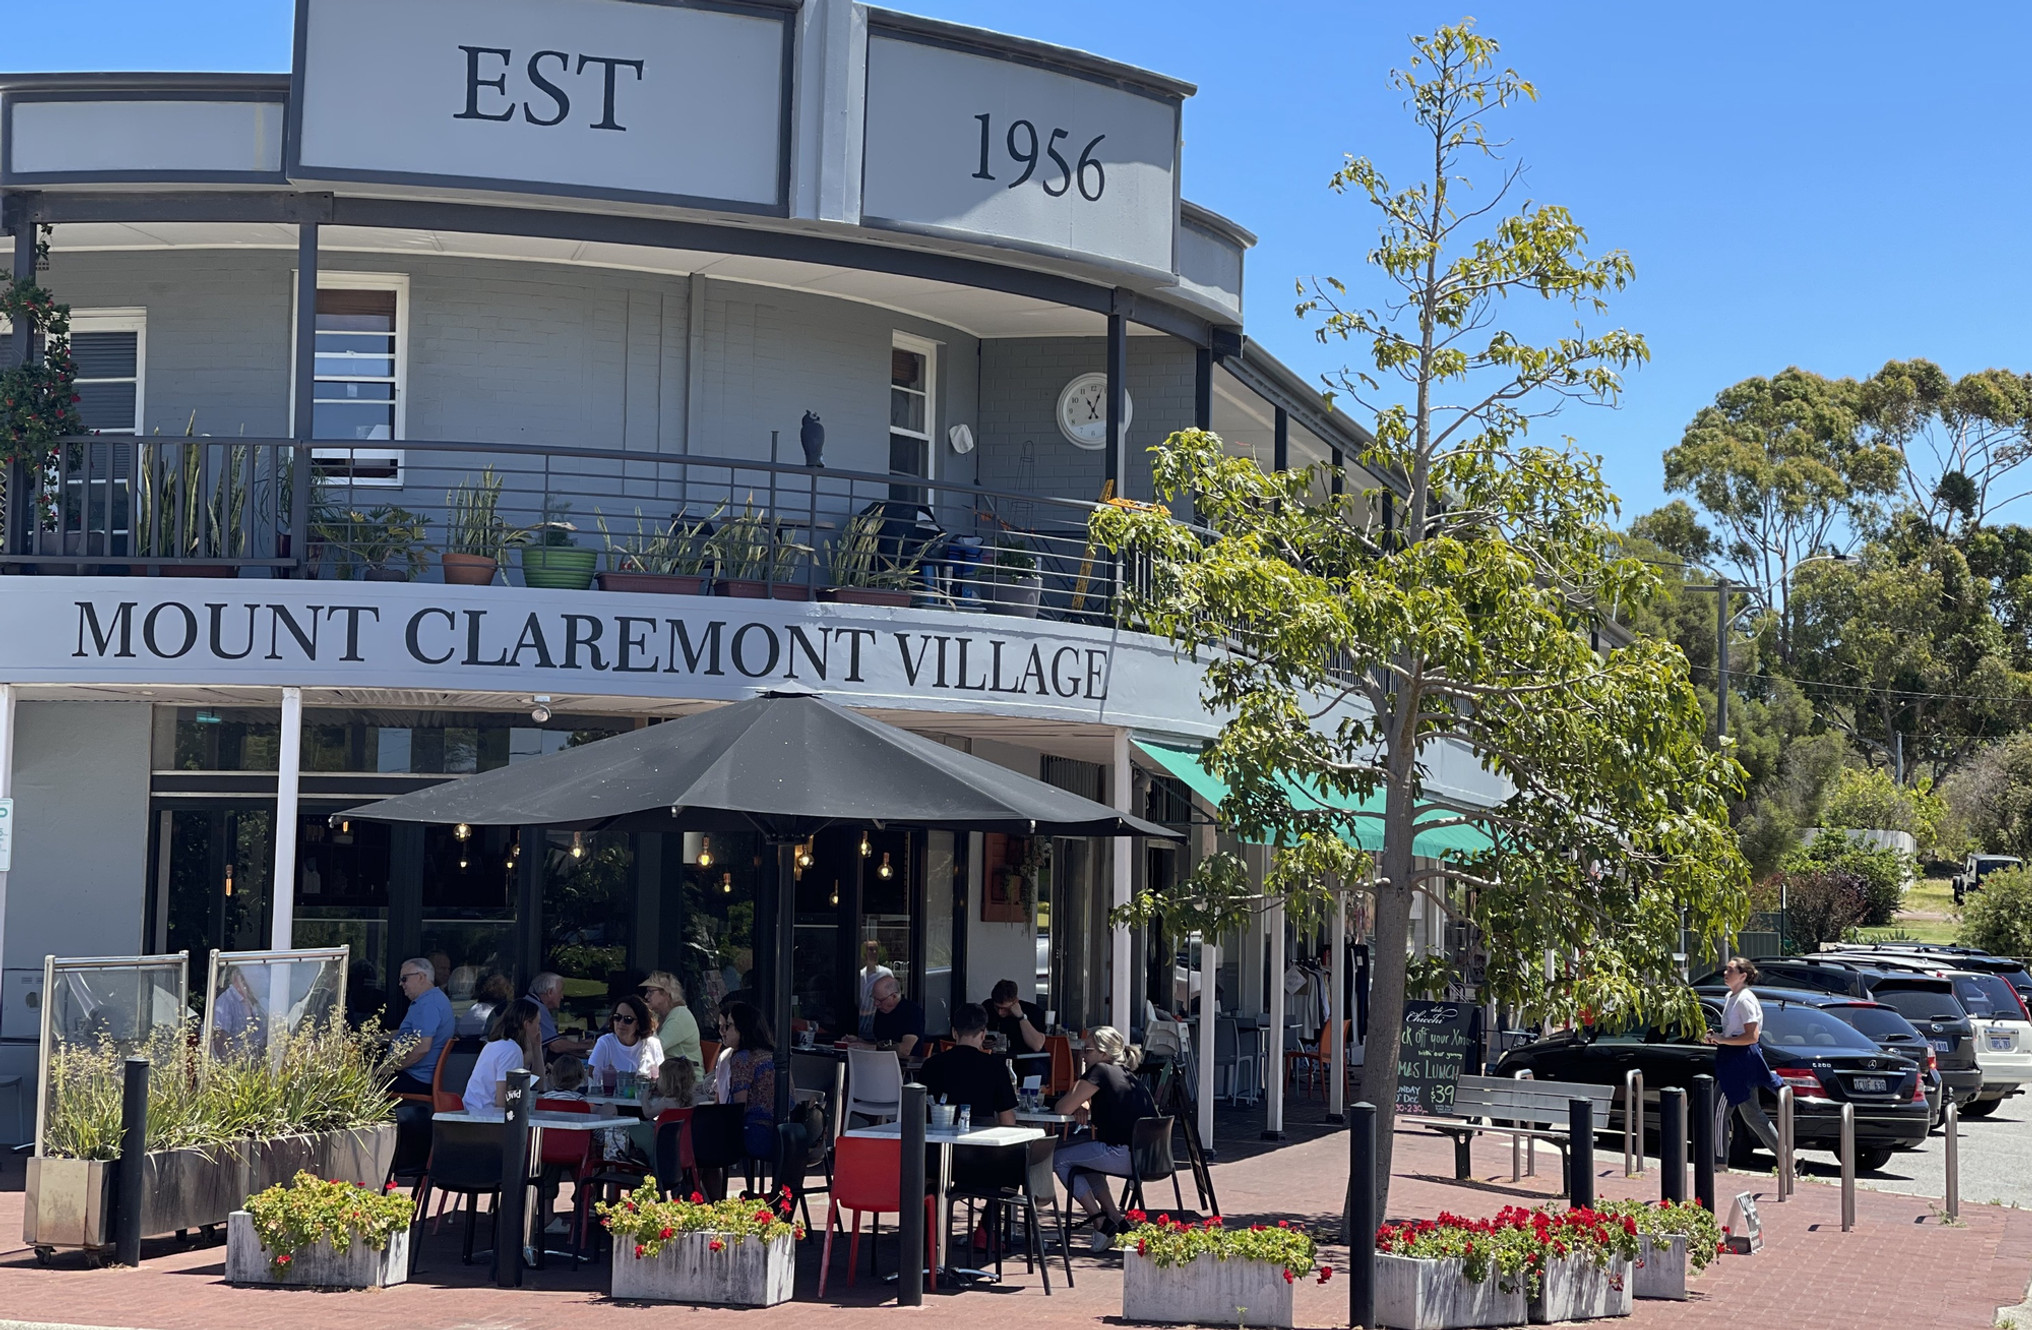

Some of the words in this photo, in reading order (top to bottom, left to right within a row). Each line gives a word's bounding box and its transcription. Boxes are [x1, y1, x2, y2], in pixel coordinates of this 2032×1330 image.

[453, 45, 645, 131] EST
[971, 112, 1106, 202] 1956
[71, 601, 380, 662] MOUNT
[404, 607, 876, 683] CLAREMONT
[894, 632, 1109, 701] VILLAGE
[1415, 1026, 1430, 1048] off
[1430, 1034, 1450, 1052] your
[1397, 1060, 1420, 1079] MAS
[1425, 1059, 1460, 1081] LUNCH
[1396, 1084, 1421, 1096] UNDAY
[1430, 1084, 1455, 1105] $39
